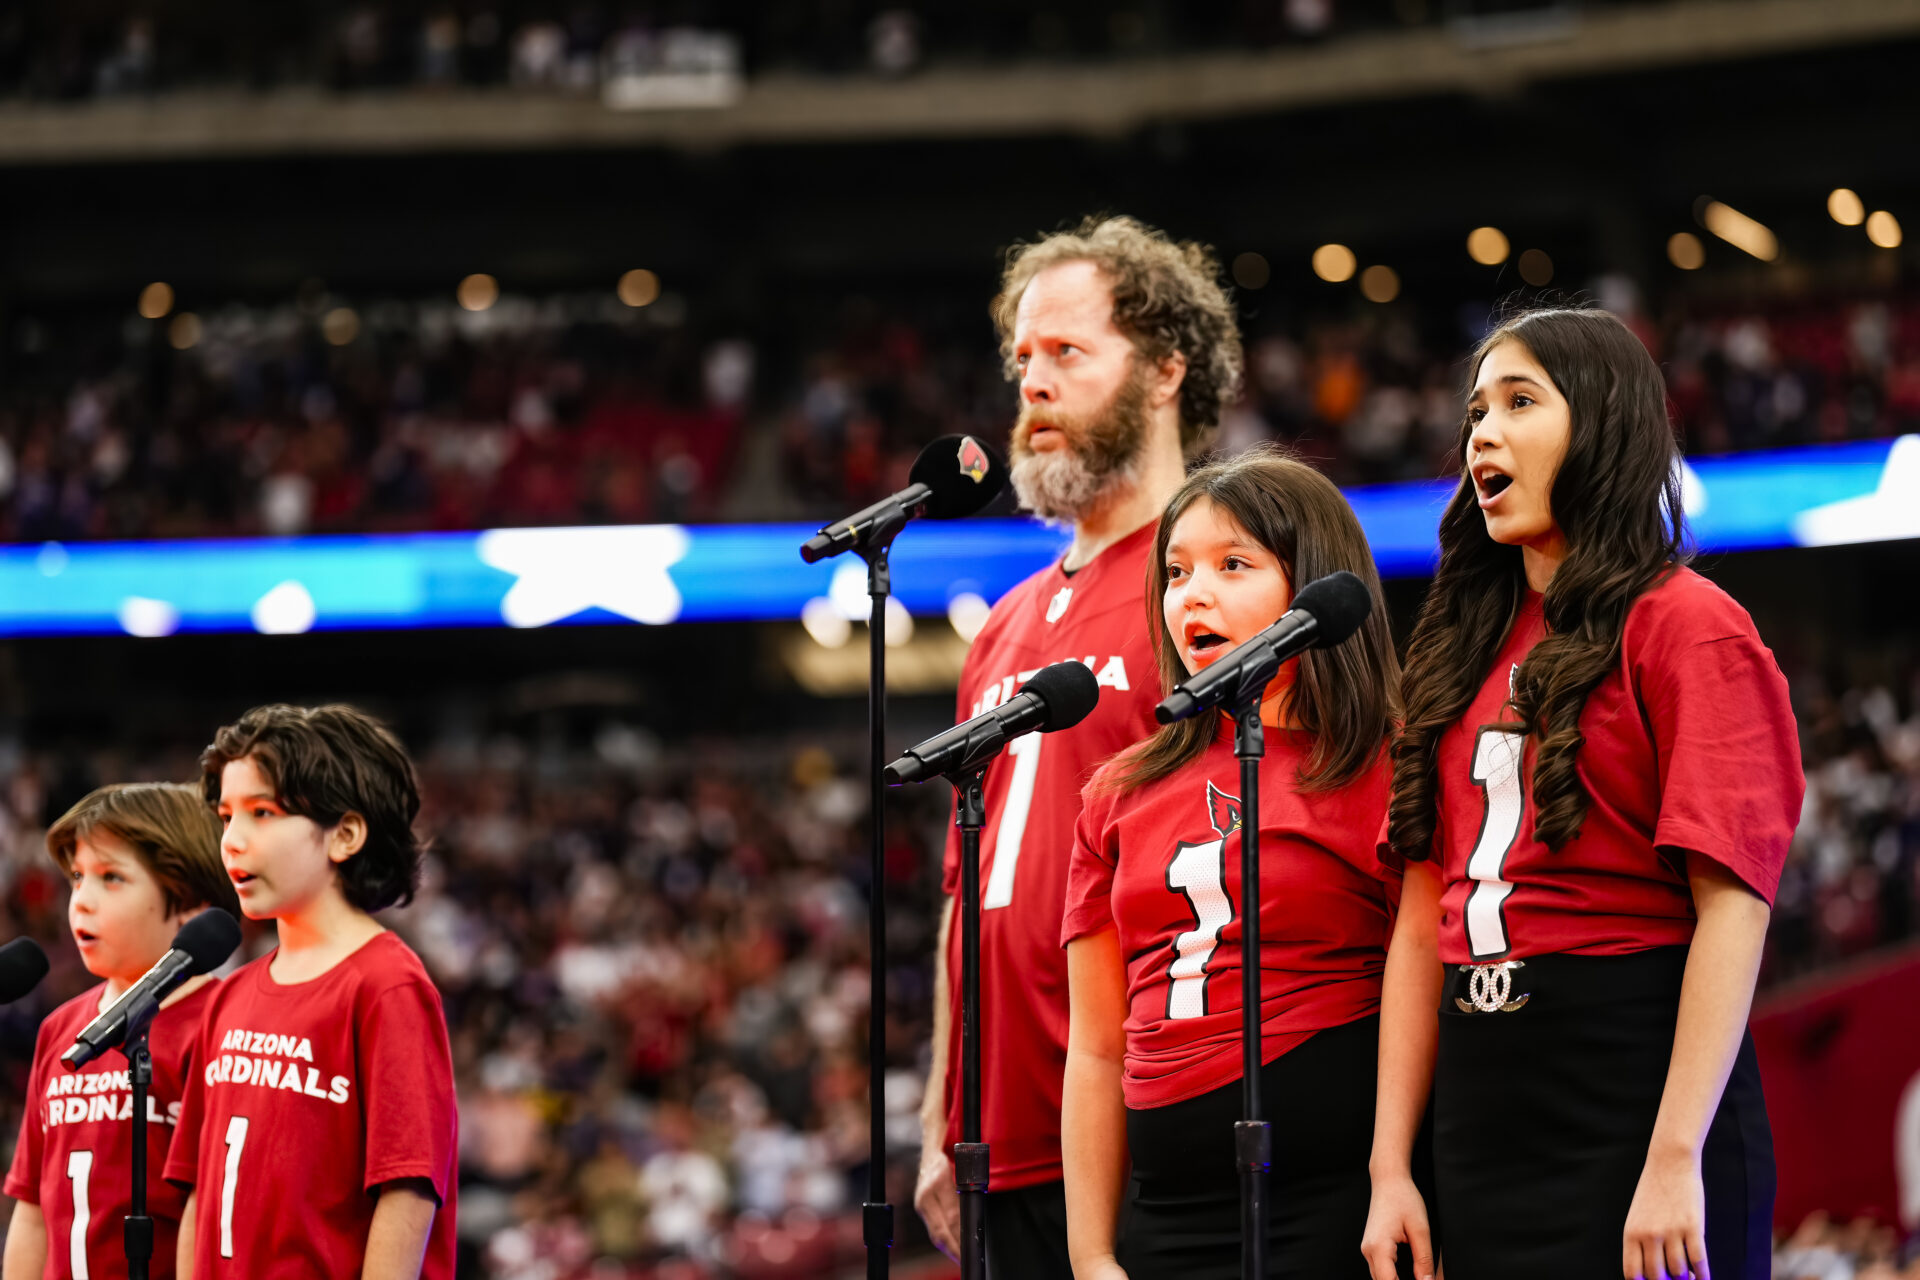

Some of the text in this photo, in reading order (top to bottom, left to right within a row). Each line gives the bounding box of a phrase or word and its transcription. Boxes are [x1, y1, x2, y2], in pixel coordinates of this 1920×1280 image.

[1465, 722, 1527, 962] 1
[1165, 839, 1236, 1020] 1
[46, 1070, 133, 1098] ARIZON
[220, 1029, 314, 1062] ARIZONA
[66, 1150, 93, 1280] 1
[220, 1115, 249, 1259] 1
